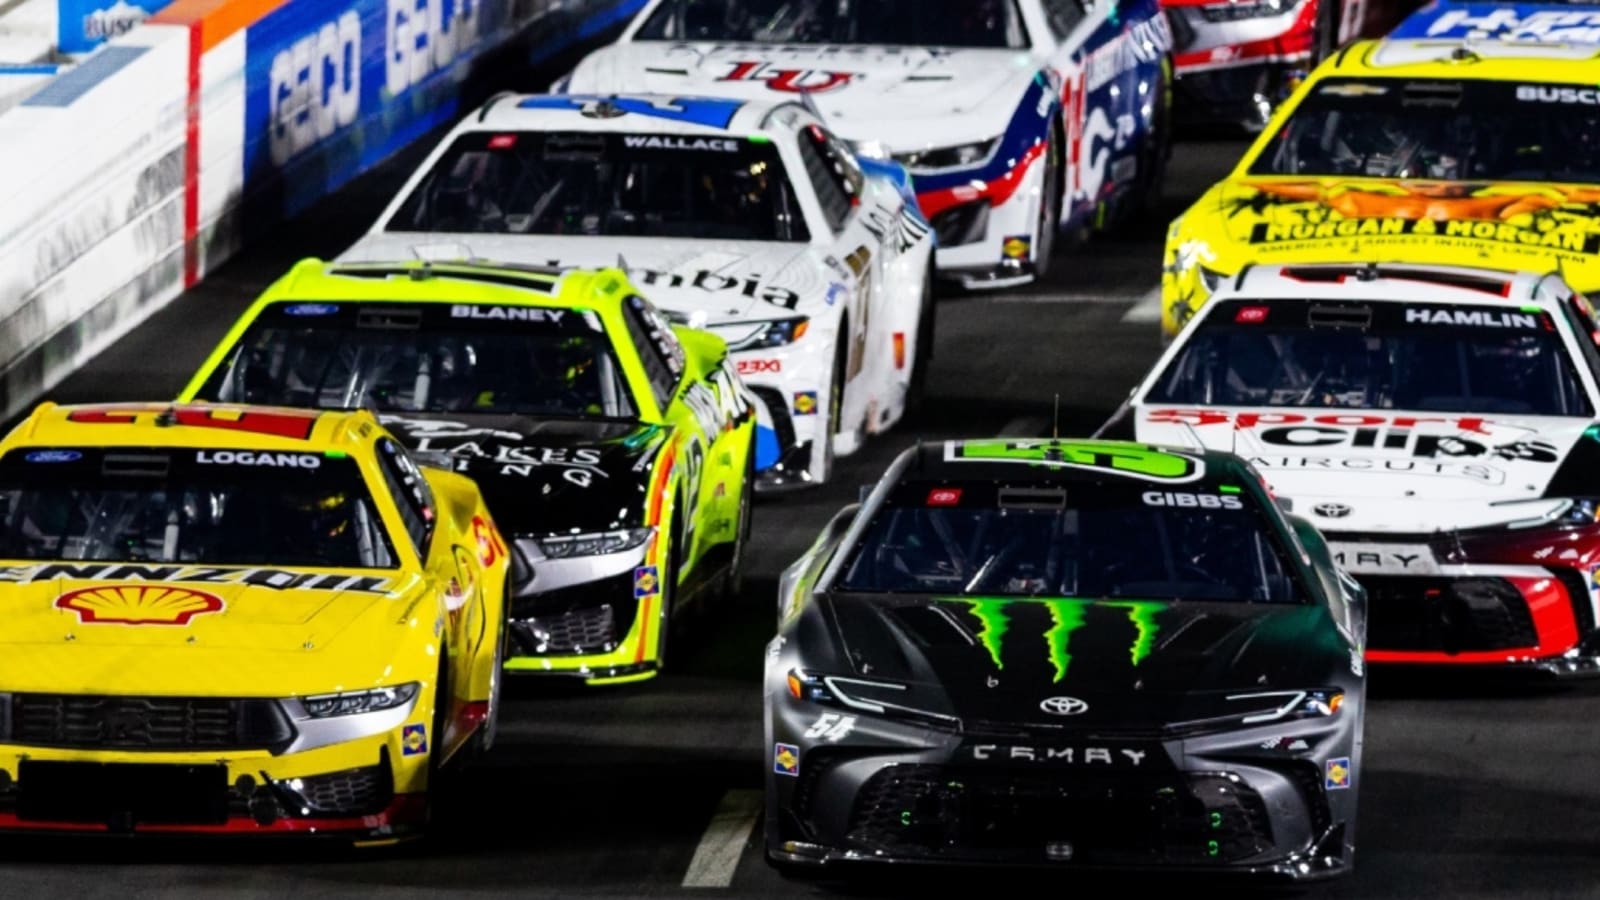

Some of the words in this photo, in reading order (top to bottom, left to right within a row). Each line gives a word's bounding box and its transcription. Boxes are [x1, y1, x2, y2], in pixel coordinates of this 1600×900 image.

[270, 10, 361, 166] GEICO
[624, 136, 738, 152] WALLACE
[1265, 219, 1404, 240] MORGAN
[1411, 219, 1436, 233] &
[1446, 221, 1586, 250] MORGAN
[451, 305, 563, 322] BLANEY
[1406, 309, 1537, 329] HAMLIN
[1147, 409, 1495, 434] Sport
[417, 438, 601, 464] LAKES
[1261, 427, 1558, 463] Clips
[196, 451, 321, 468] LOGANO
[1142, 492, 1243, 509] GIBBS
[804, 713, 856, 742] 54
